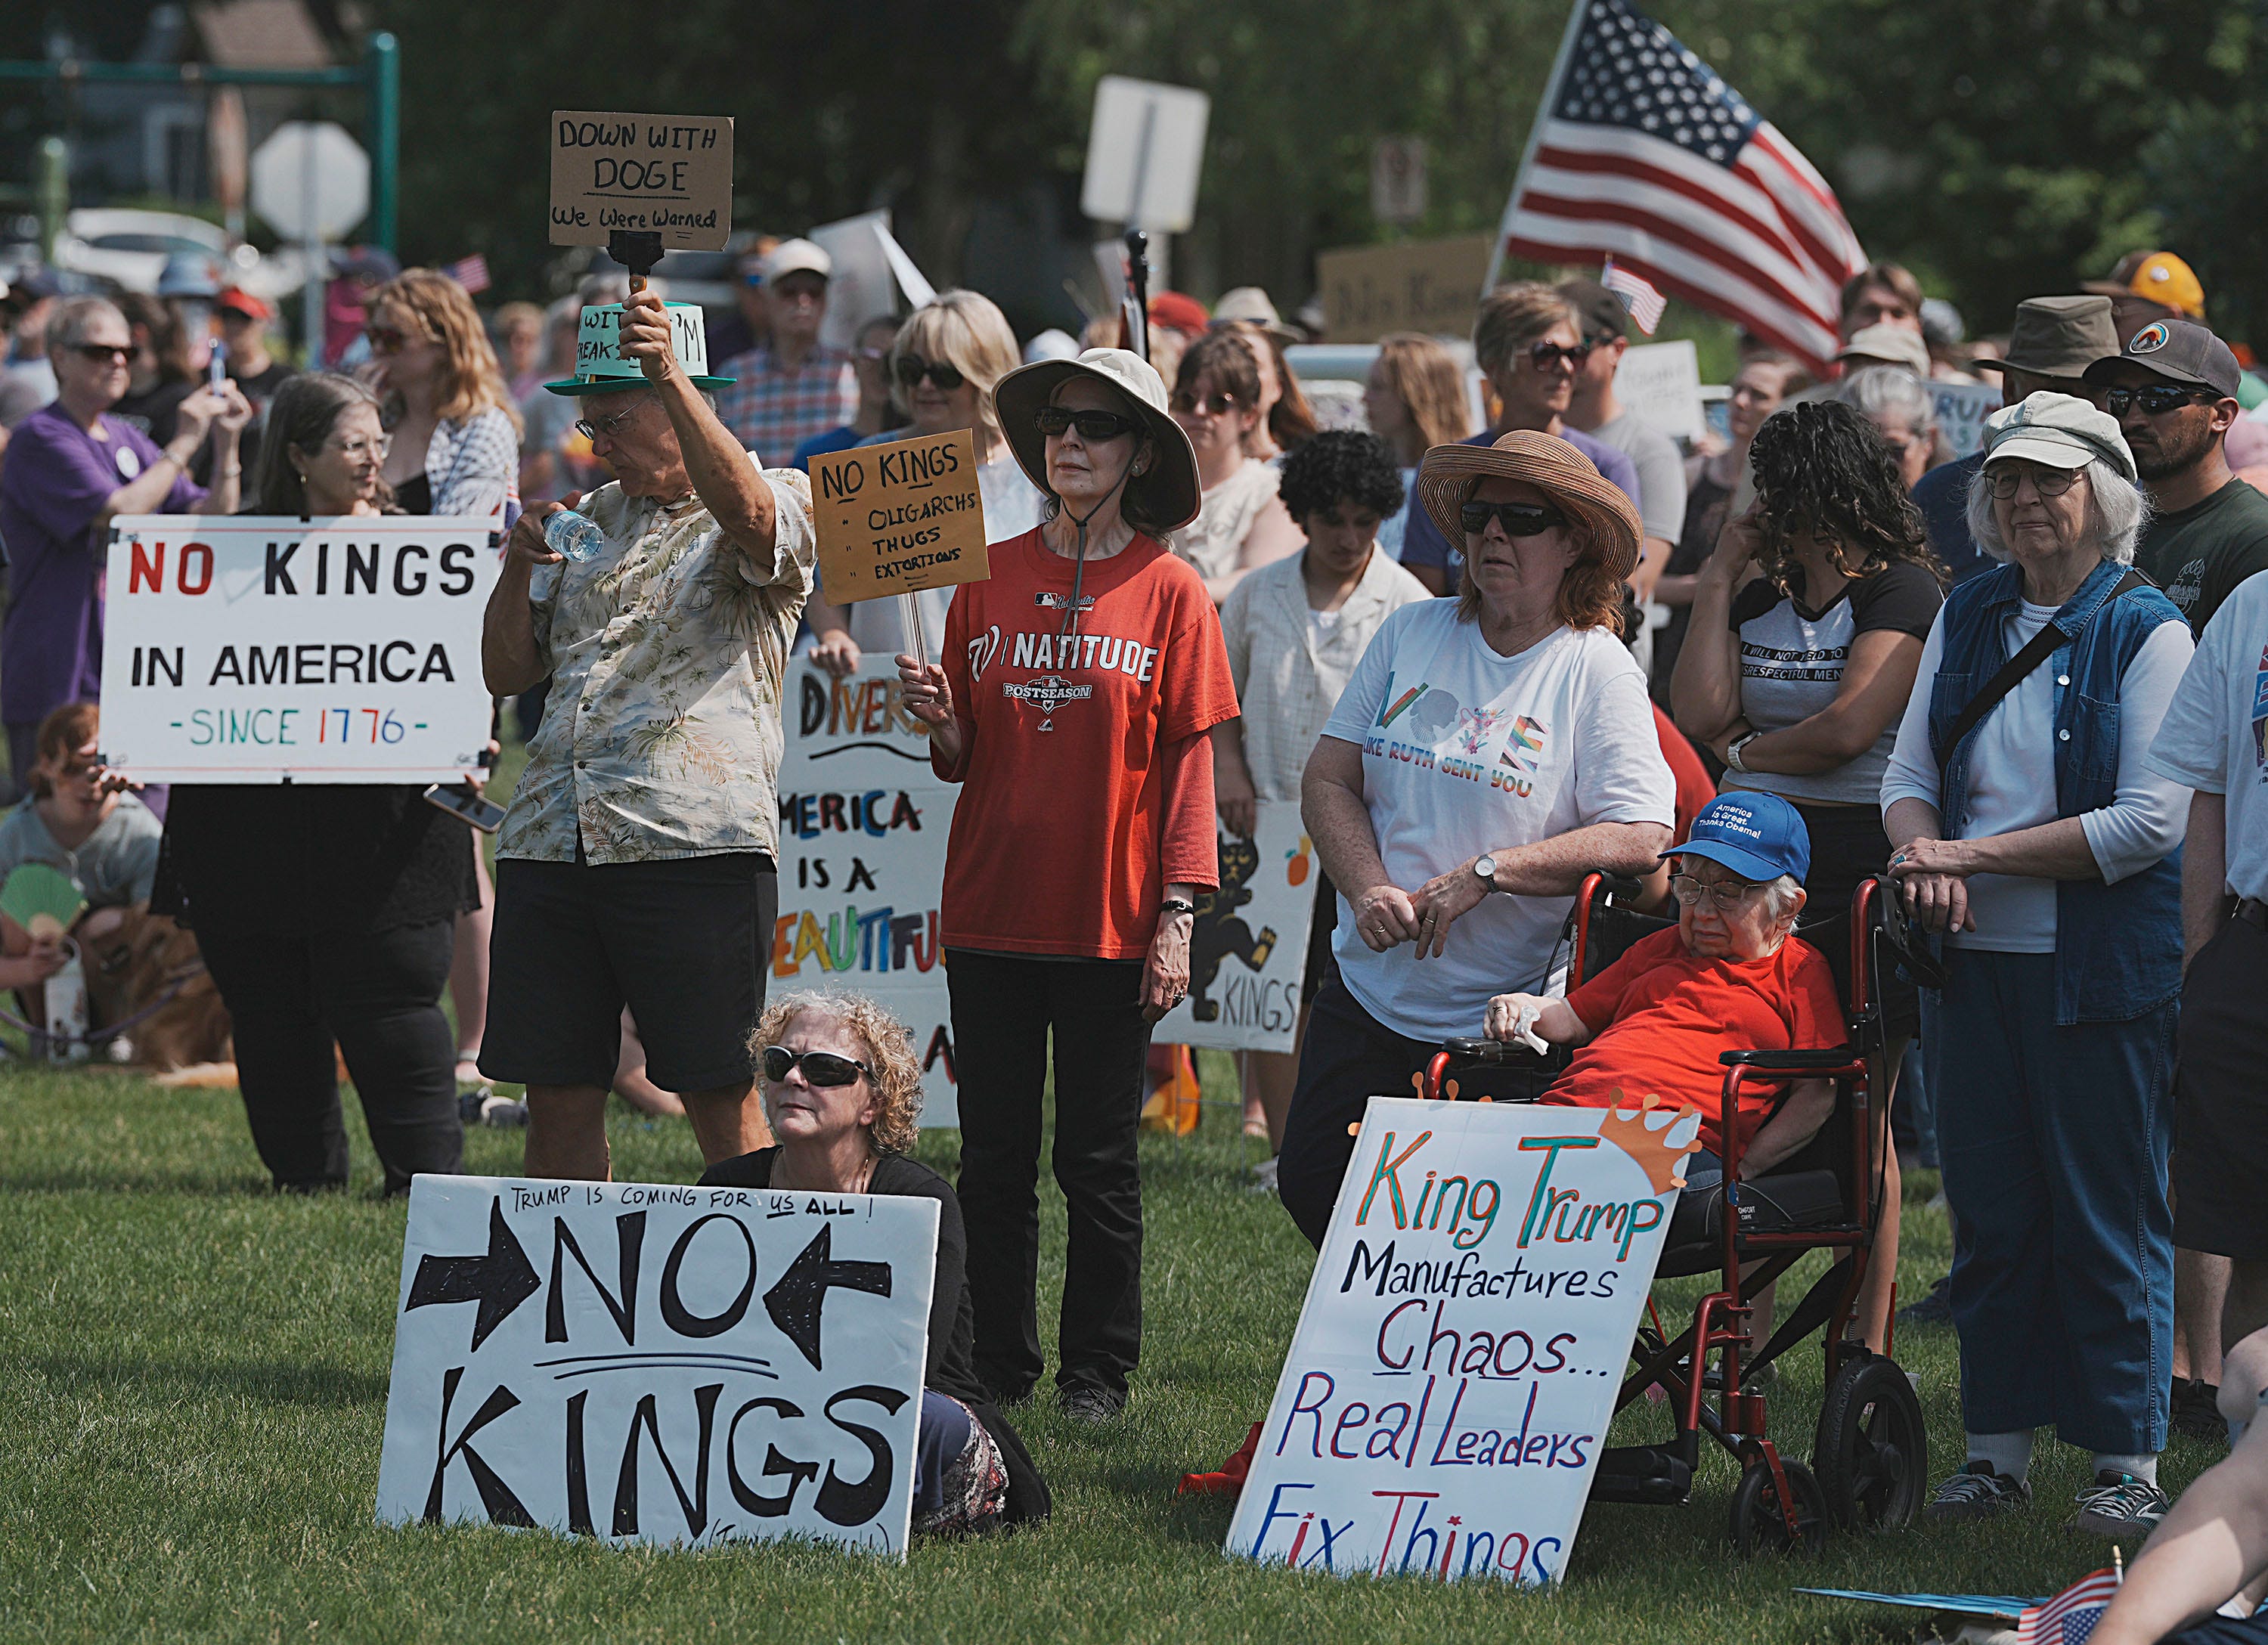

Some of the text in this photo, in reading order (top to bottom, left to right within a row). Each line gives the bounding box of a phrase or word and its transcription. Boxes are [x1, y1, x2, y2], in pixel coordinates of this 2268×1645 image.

[559, 119, 717, 150] DOWN WITH
[594, 157, 689, 191] DOGE
[552, 206, 717, 228] We Were Warned
[584, 311, 624, 330] WIT
[821, 443, 959, 499] NO KINGS
[868, 492, 976, 531] OLIGARCHS
[872, 526, 940, 556] THUGS
[129, 542, 475, 596] NO KINGS
[875, 548, 962, 580] EXTORTIONS
[132, 640, 455, 687] IN AMERICA
[1012, 632, 1159, 682] NATITUDE
[1741, 665, 1843, 680] SRESPECTFUL MEN
[1749, 646, 1771, 658] WILL
[1774, 651, 1799, 661] NOT
[1830, 648, 1843, 658] TO
[799, 671, 930, 739] DIVER
[1003, 684, 1091, 699] POSTSEASON
[1389, 741, 1436, 770] RUTH
[1441, 757, 1485, 782] SENT
[1490, 769, 1533, 798] YOU
[778, 789, 923, 840] MERICA
[1699, 819, 1761, 839] Thanks Obama!
[1716, 804, 1752, 819] America
[1721, 812, 1748, 826] Great.
[798, 857, 880, 893] IS A
[769, 906, 946, 978] EAUTIFU
[1222, 974, 1298, 1033] KINGS
[511, 1185, 571, 1213] TRUMP
[587, 1186, 603, 1205] IS
[621, 1187, 697, 1206] COMING
[710, 1190, 751, 1207] FOR
[770, 1194, 794, 1212] US
[1356, 1130, 1664, 1262] King Trump
[544, 1210, 757, 1347] NO
[1340, 1239, 1619, 1300] Manufactures
[1276, 1371, 1594, 1468] Real Leaders
[422, 1365, 912, 1539] KINGS
[1250, 1483, 1355, 1572] Fix
